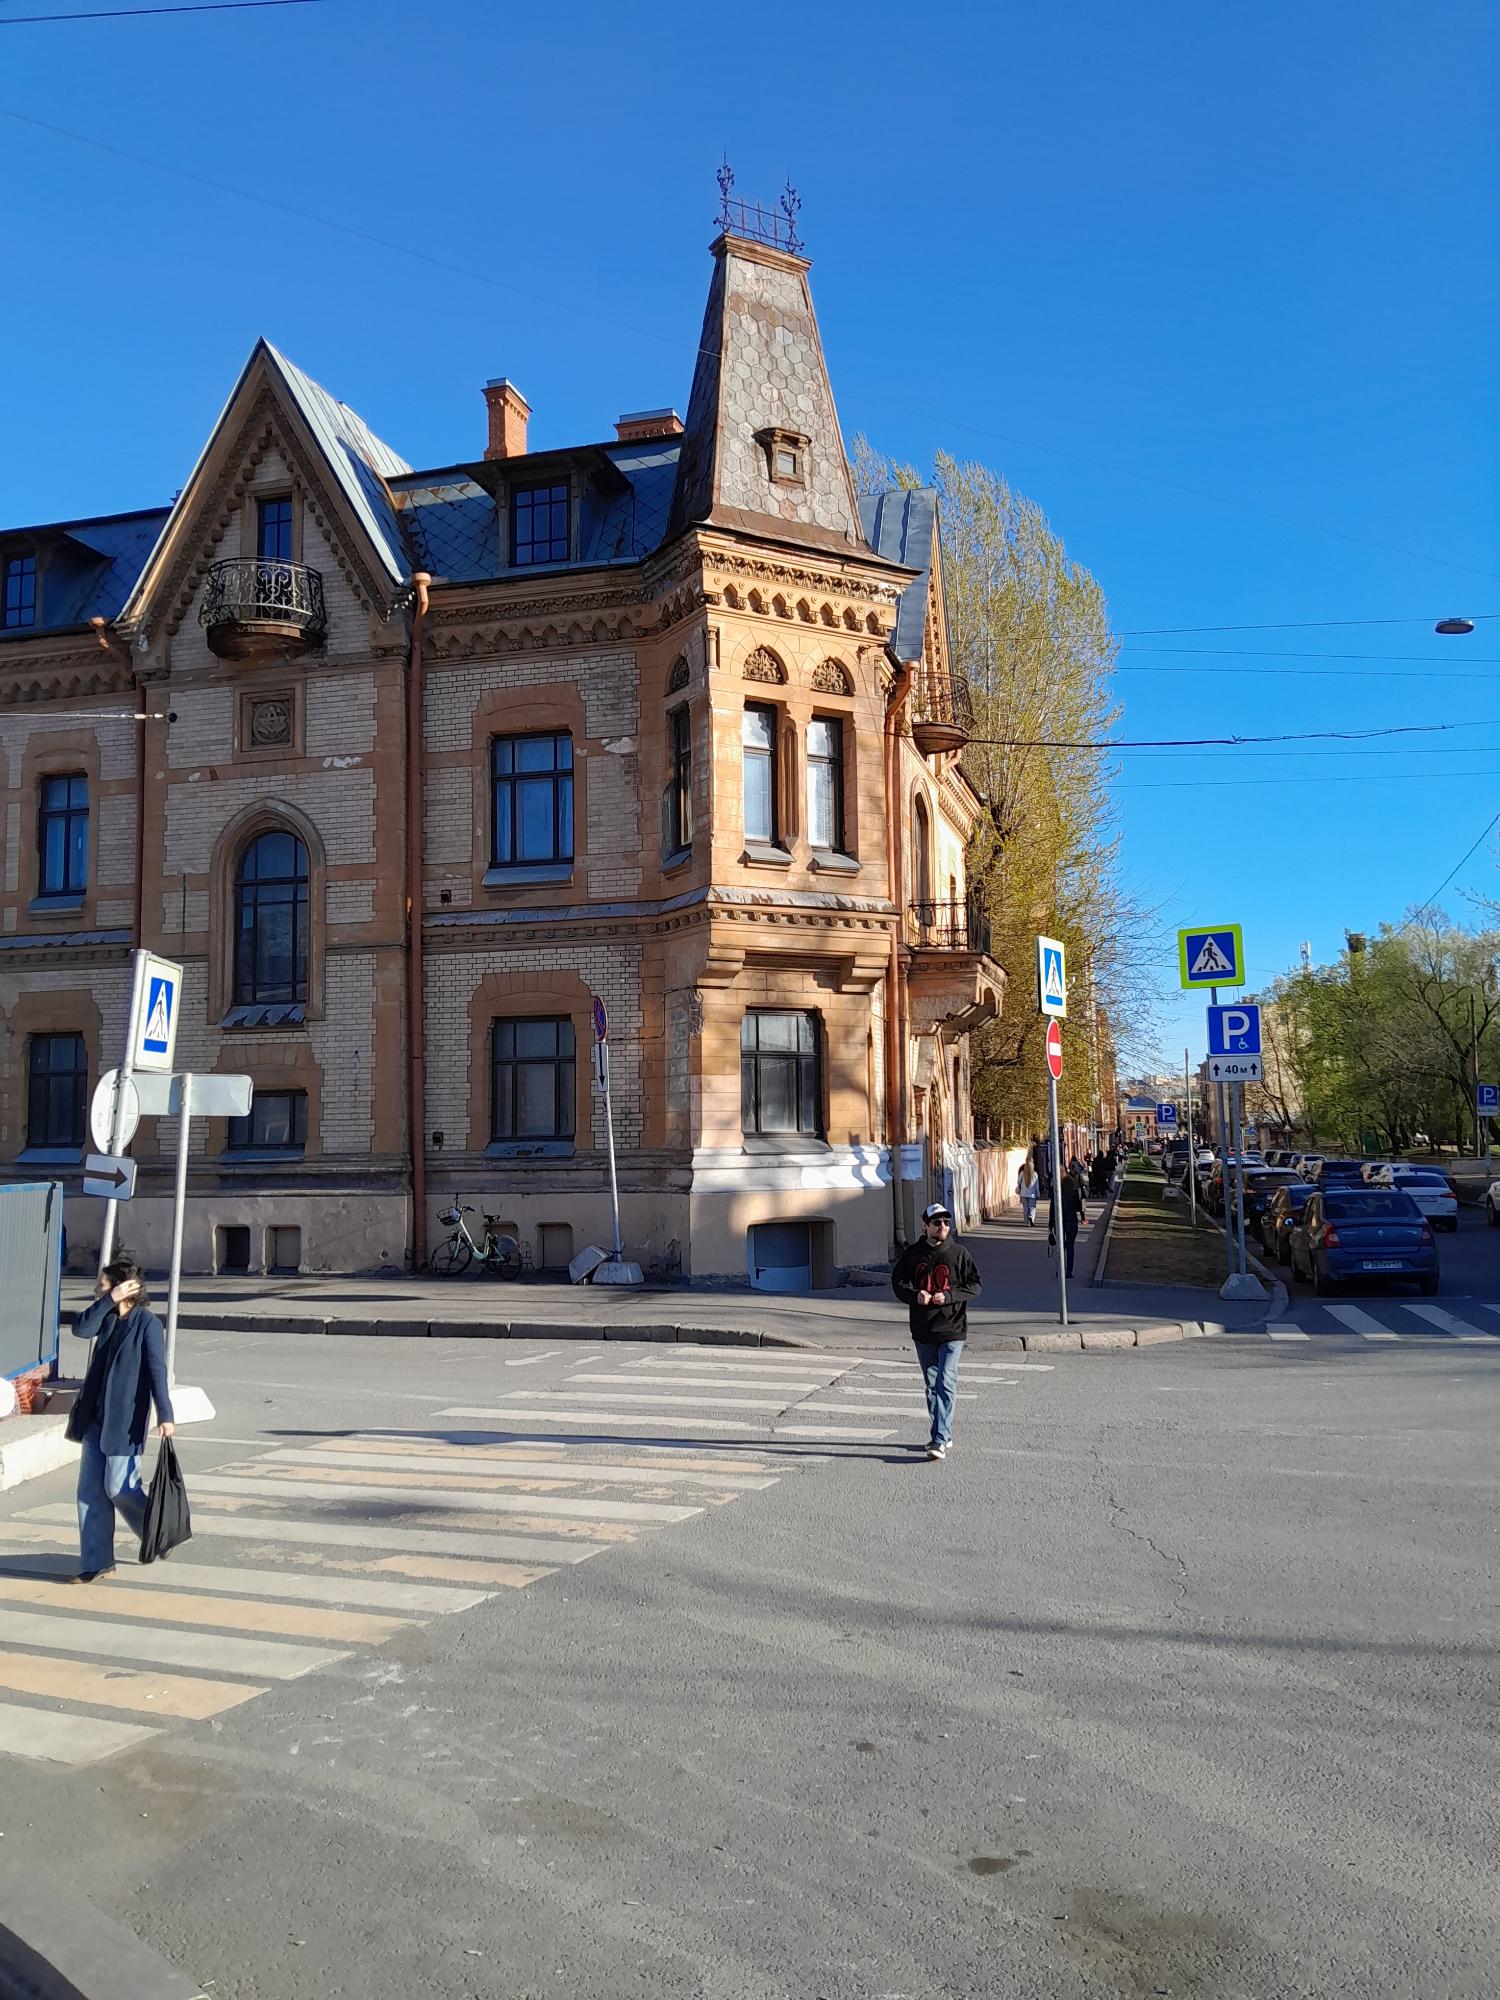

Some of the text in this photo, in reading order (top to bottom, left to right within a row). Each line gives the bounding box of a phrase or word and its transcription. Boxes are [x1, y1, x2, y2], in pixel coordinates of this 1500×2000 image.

[1222, 1011, 1250, 1050] P
[1483, 1087, 1495, 1103] P
[1161, 1105, 1173, 1121] P
